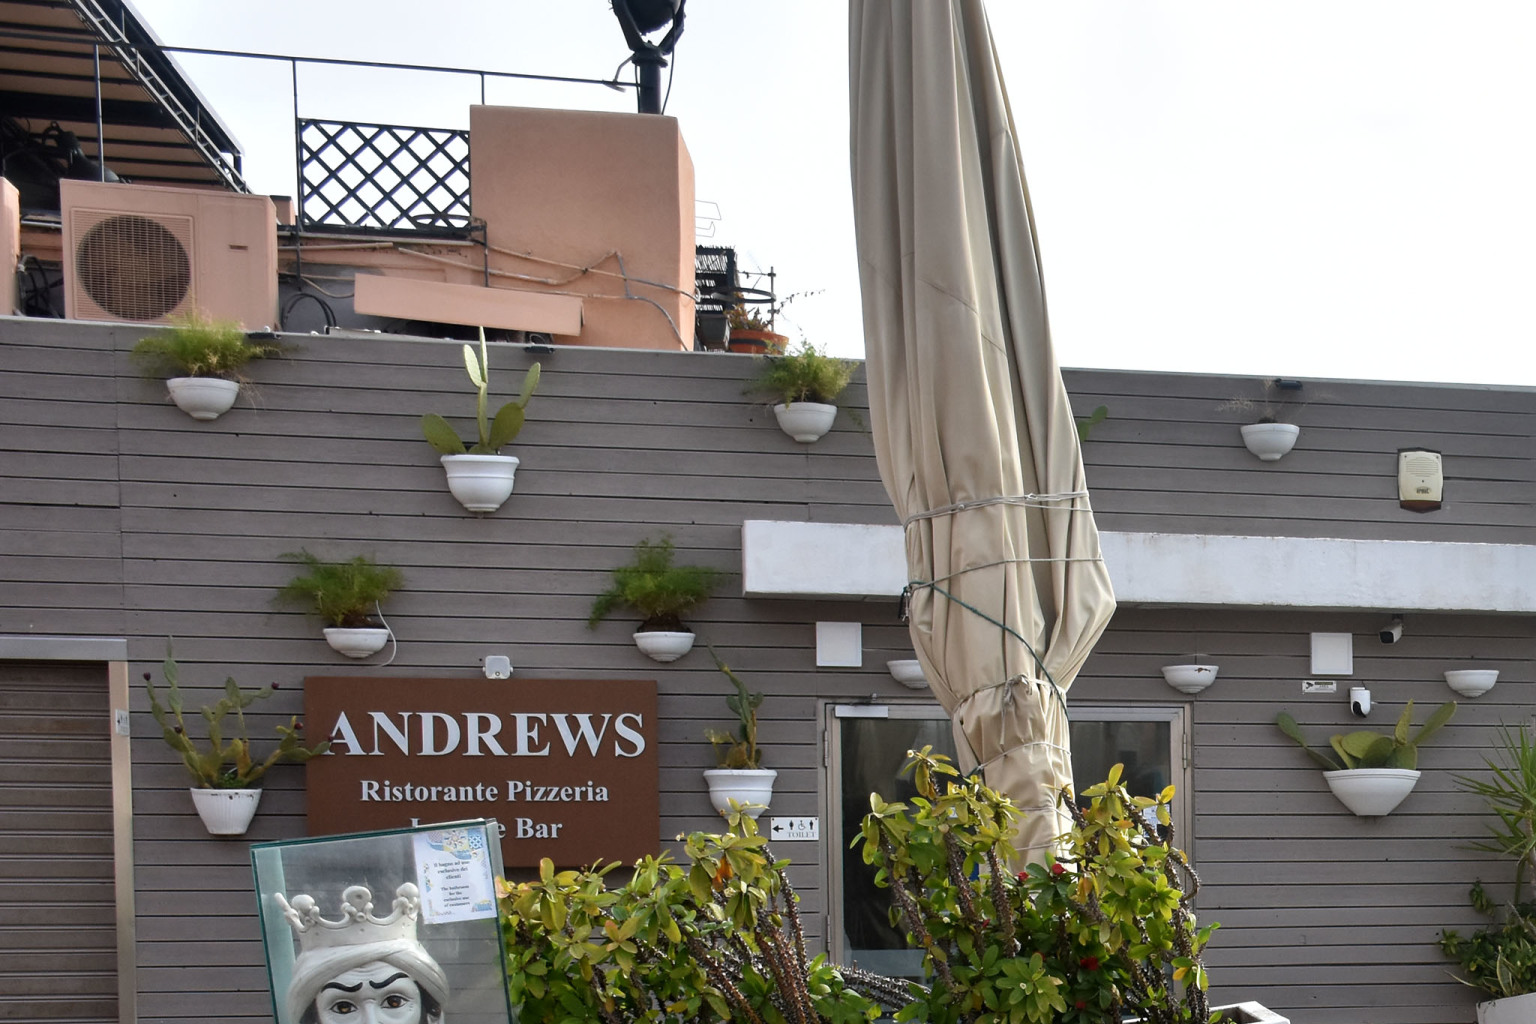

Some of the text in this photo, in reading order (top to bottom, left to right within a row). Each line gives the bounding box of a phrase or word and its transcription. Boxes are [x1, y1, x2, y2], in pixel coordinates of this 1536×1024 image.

[321, 711, 646, 758] ANDREWS
[360, 780, 609, 802] Ristorante Pizzeria
[515, 817, 563, 839] Bar
